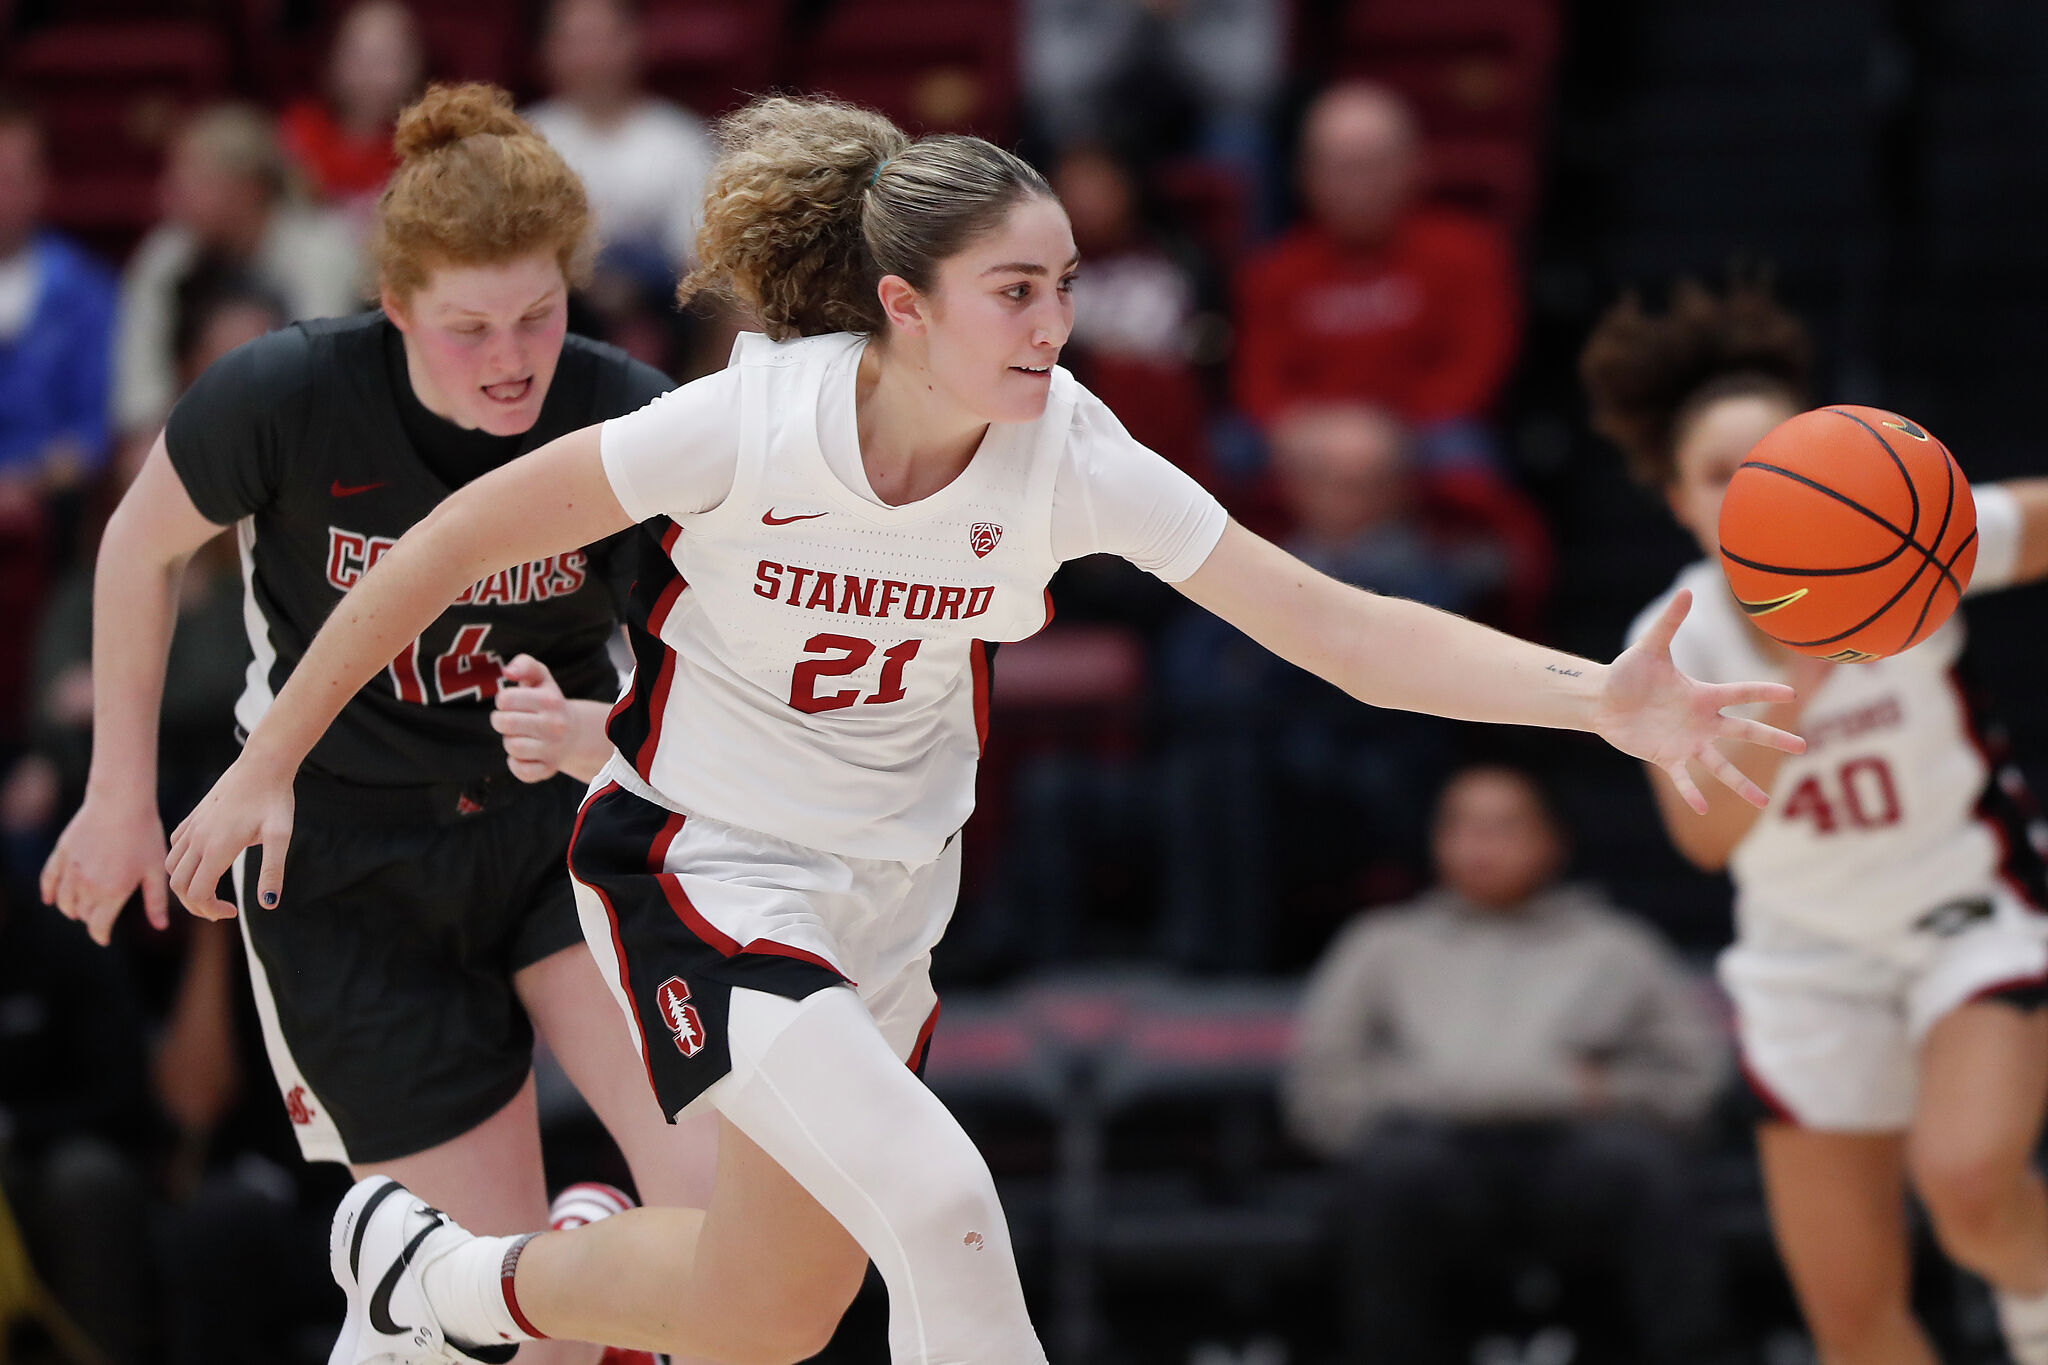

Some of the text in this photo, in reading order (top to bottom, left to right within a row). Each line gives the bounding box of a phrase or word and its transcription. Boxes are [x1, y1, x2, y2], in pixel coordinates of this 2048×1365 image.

[971, 522, 1003, 546] PAC
[974, 538, 992, 552] 12
[753, 559, 995, 620] STANFORD
[387, 622, 508, 706] 14
[789, 632, 922, 714] 21
[1781, 755, 1903, 834] 40
